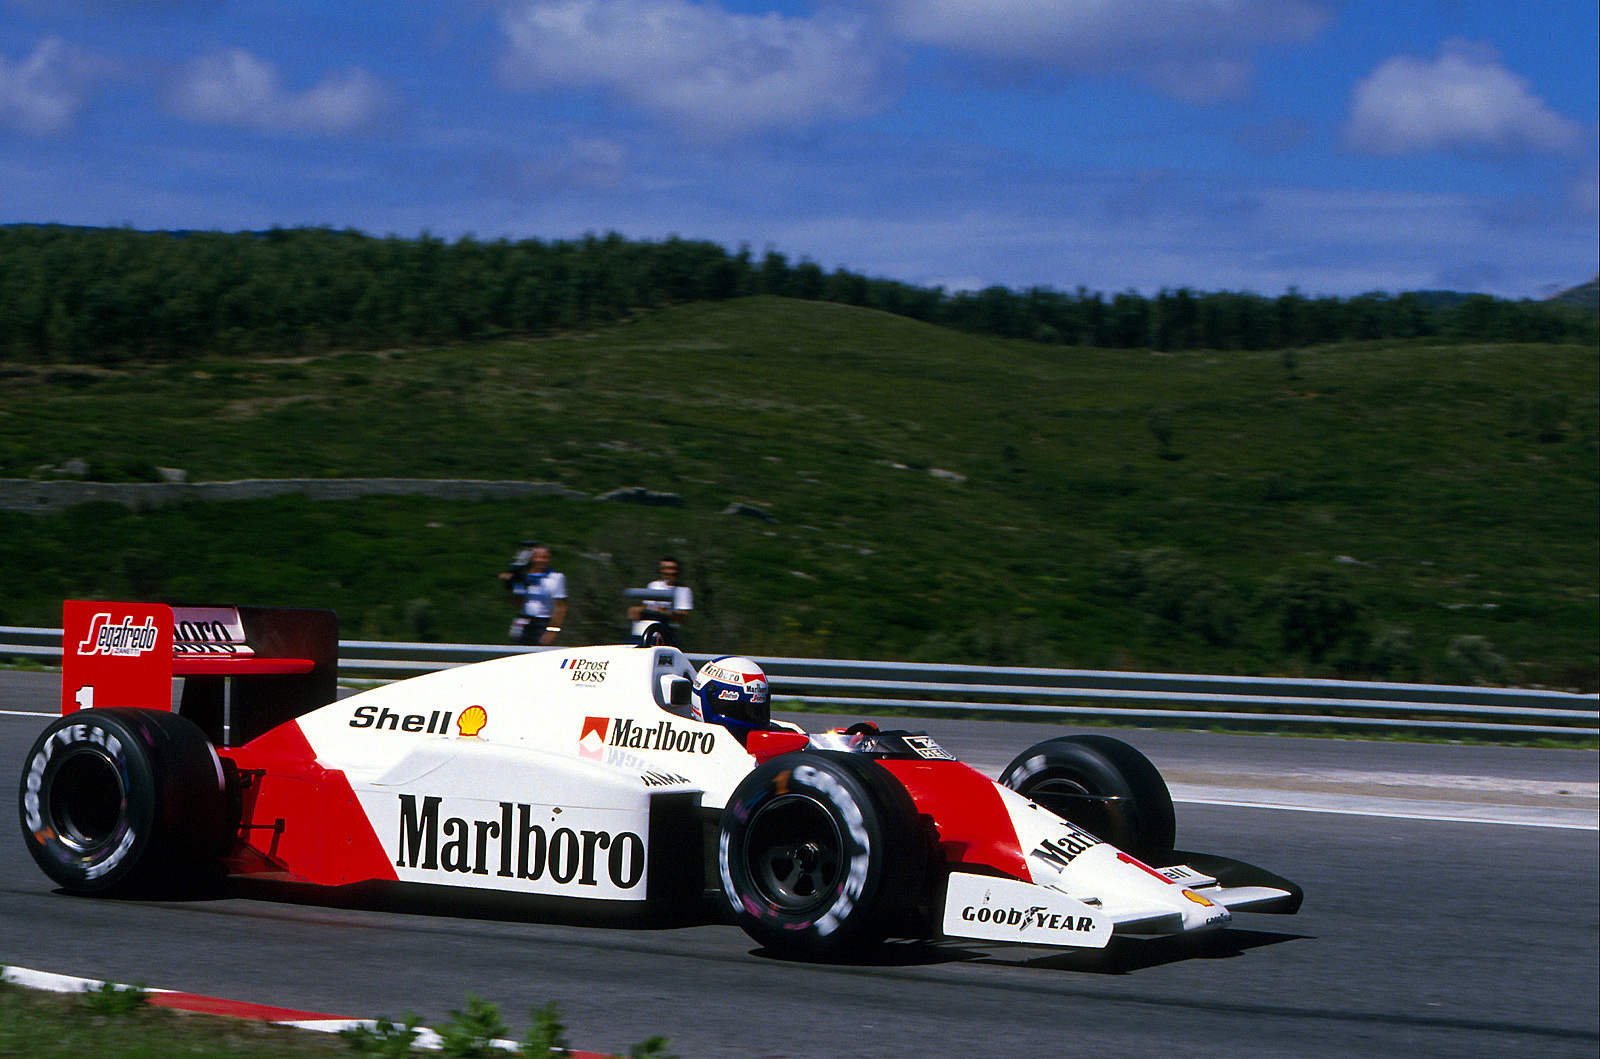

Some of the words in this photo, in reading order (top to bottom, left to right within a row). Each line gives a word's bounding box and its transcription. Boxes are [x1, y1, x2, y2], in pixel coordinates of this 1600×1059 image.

[77, 612, 158, 656] Segafredo
[571, 670, 607, 683] BOSS
[576, 659, 610, 671] Prost
[76, 685, 94, 710] 1
[349, 705, 453, 735] Shell
[609, 717, 716, 755] Marlboro
[396, 793, 646, 889] Marlboro
[1029, 821, 1105, 875] Marl
